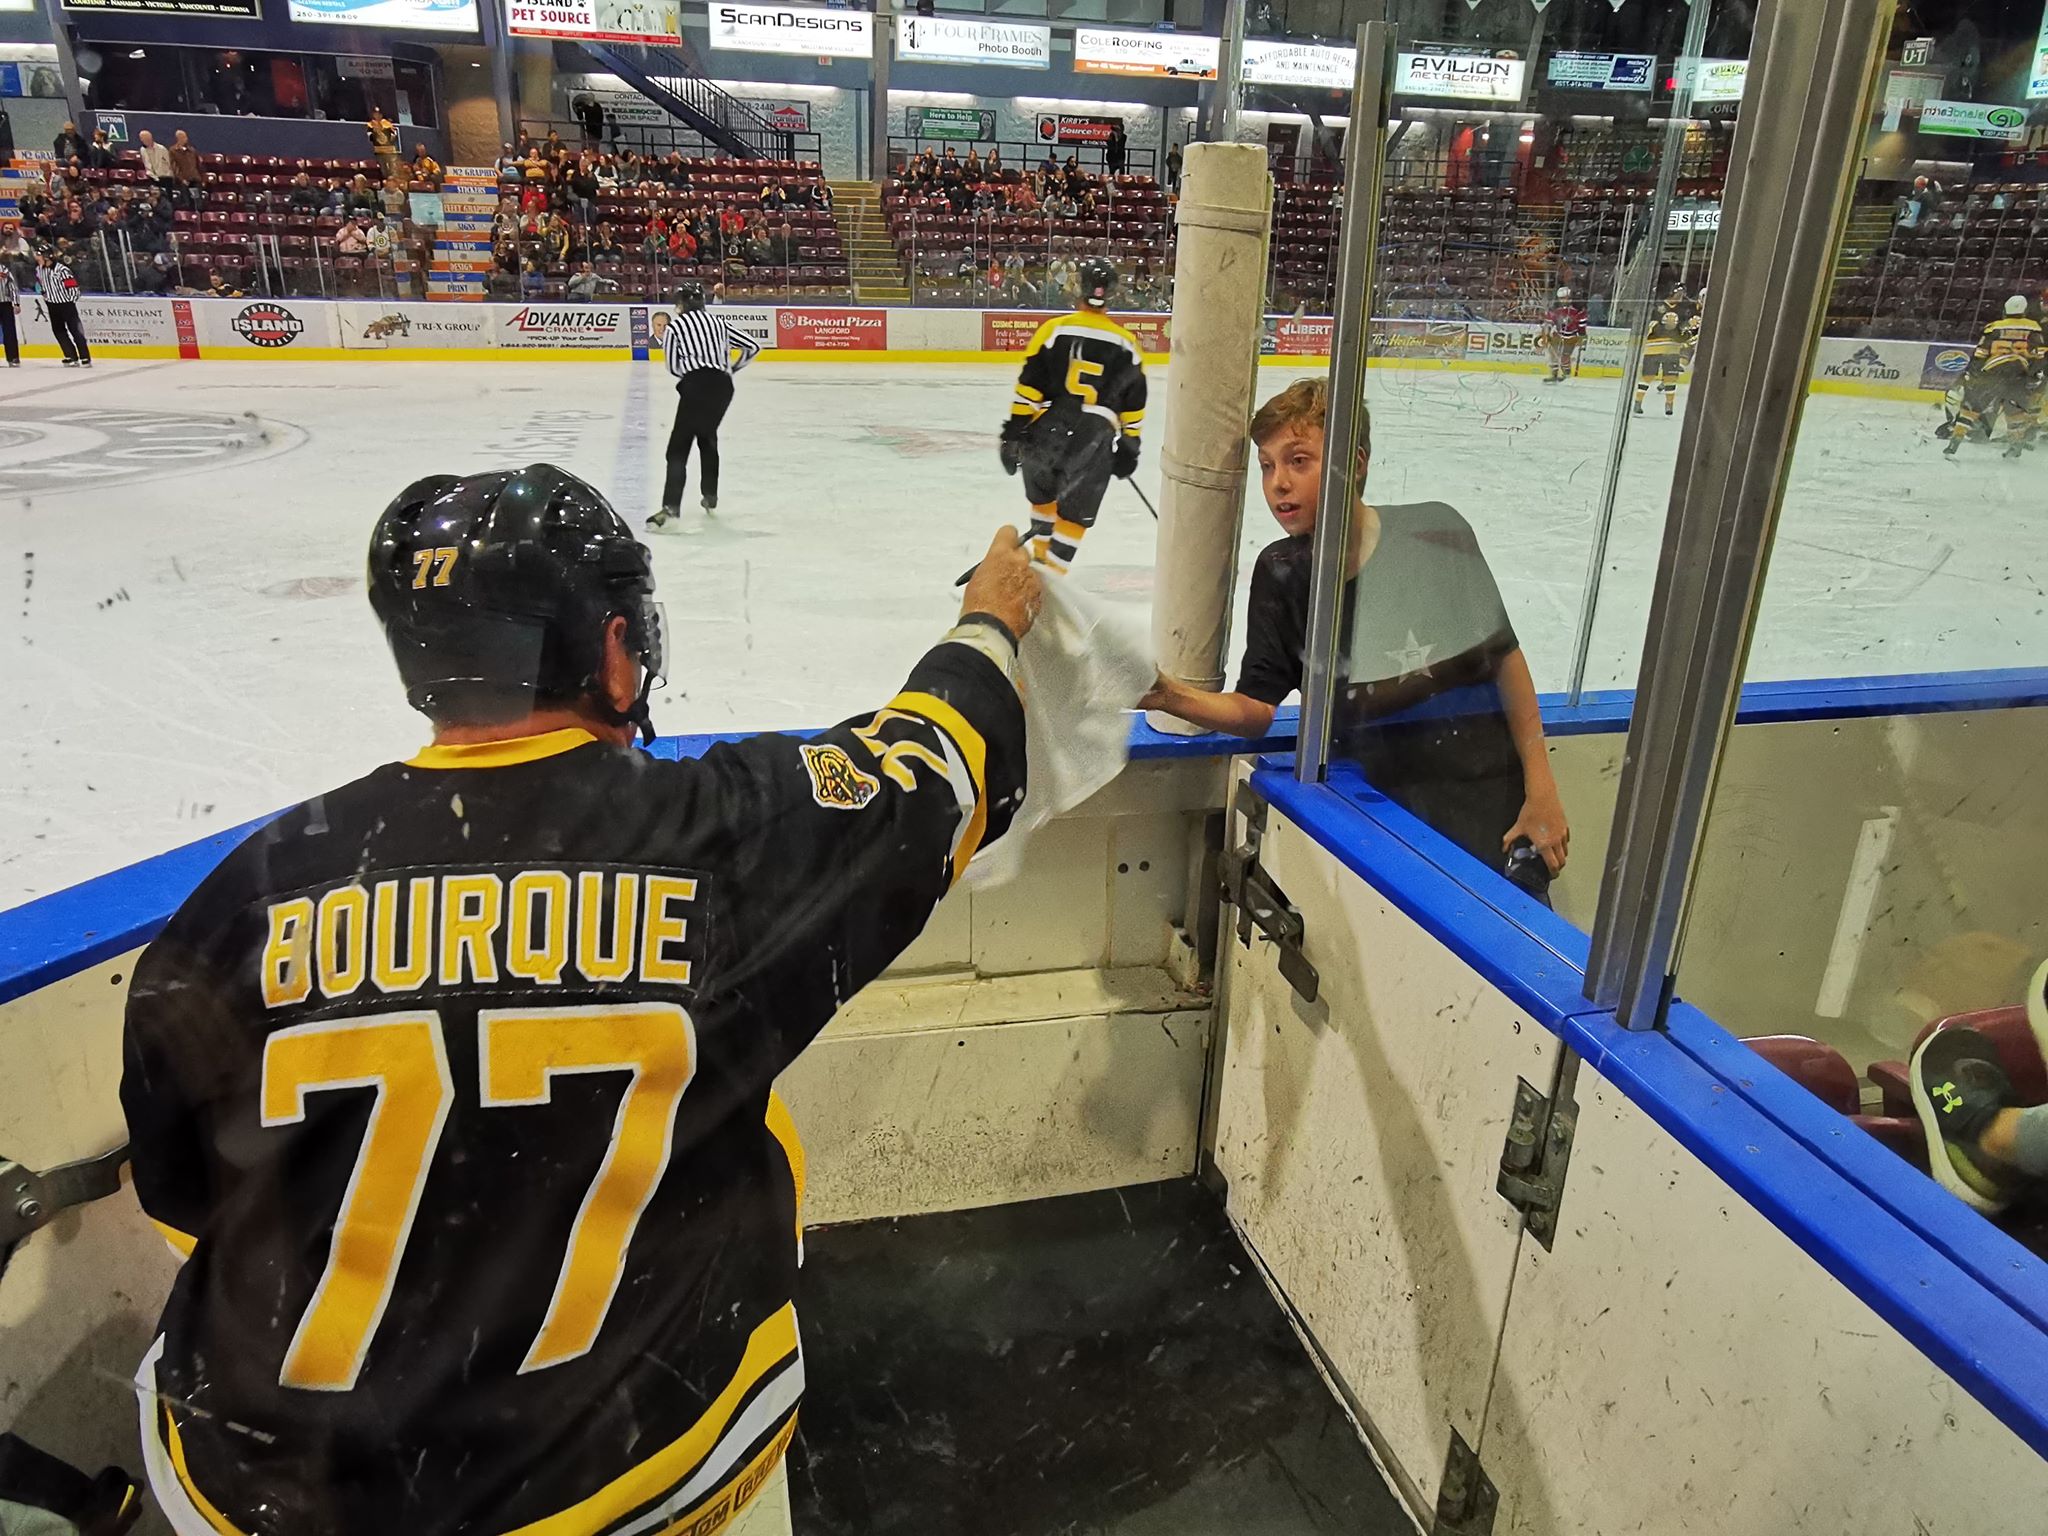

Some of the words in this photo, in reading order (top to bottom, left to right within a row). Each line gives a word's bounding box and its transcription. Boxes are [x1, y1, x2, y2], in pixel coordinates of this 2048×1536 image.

[512, 8, 535, 21] PET
[540, 10, 591, 25] SOURCE
[978, 43, 1009, 54] Photo
[1012, 45, 1042, 56] Booth
[1259, 47, 1308, 64] AFFORDABLE
[1310, 48, 1331, 60] AUTO
[1276, 61, 1290, 70] AND
[1293, 62, 1338, 74] MAINTENANCE
[1410, 71, 1509, 85] METALCRAFT
[956, 113, 973, 121] Help
[1060, 117, 1090, 125] KIRBY'S
[107, 123, 120, 139] A
[1060, 127, 1092, 135] Source
[452, 242, 477, 250] WRAPS
[450, 263, 473, 271] DESIGN
[447, 284, 468, 292] PRINT
[107, 308, 163, 317] MERCHANT
[243, 304, 289, 318] PAVING
[505, 307, 620, 328] ADVANTAGE
[233, 319, 303, 332] ISLAND
[415, 322, 442, 331] TRI-X
[444, 322, 481, 331] GROUP
[797, 316, 845, 327] Boston
[845, 316, 882, 327] Pizza
[1588, 336, 1623, 346] harbour
[1824, 364, 1864, 378] MOLLY
[1866, 367, 1900, 380] MAID
[1064, 357, 1105, 406] 5
[410, 548, 459, 590] 77
[261, 869, 699, 1007] BOURQUE
[261, 1001, 698, 1392] 77
